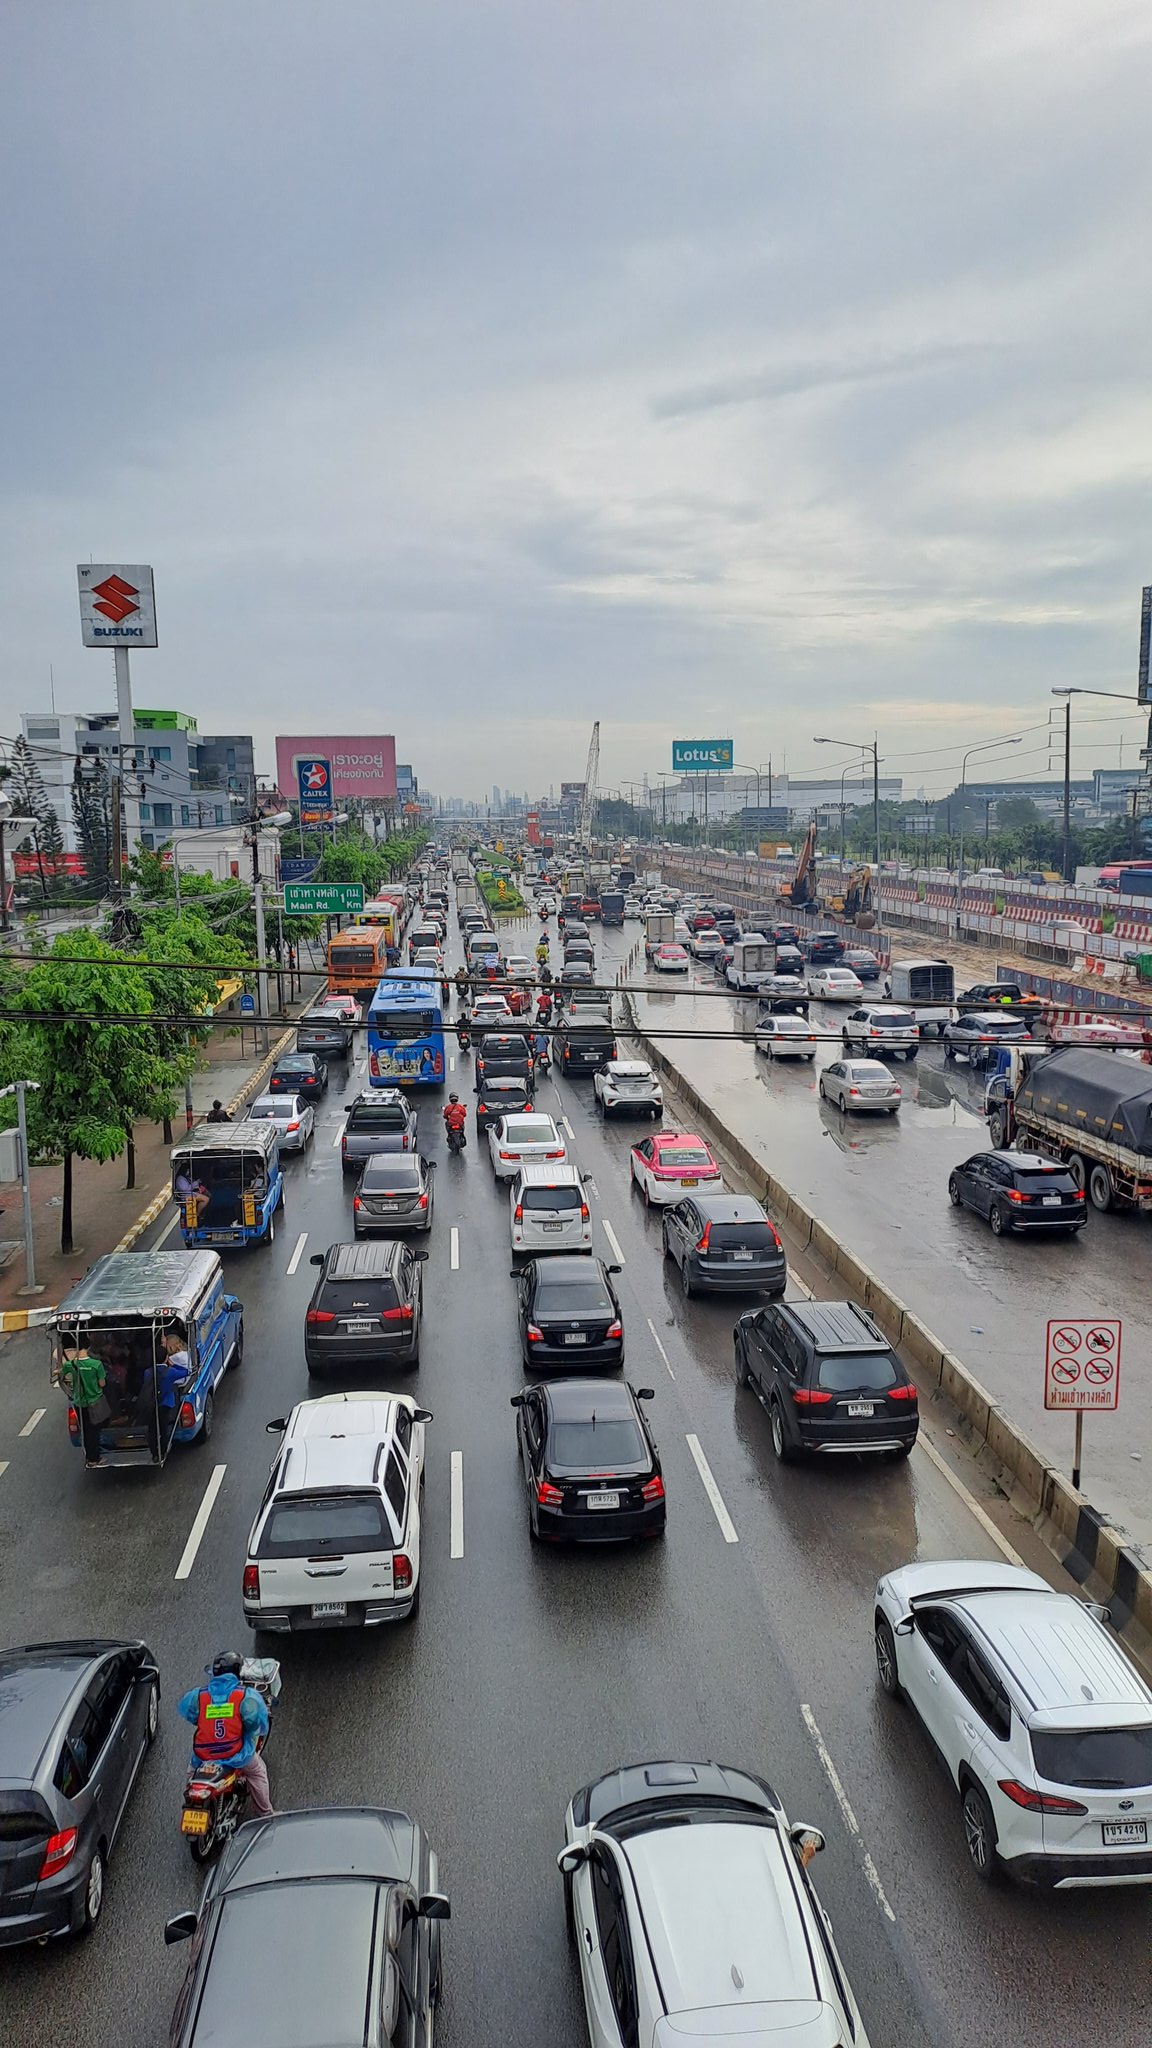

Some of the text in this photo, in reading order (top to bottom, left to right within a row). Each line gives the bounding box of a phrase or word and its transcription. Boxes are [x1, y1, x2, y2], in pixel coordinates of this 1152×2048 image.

[93, 627, 143, 637] SUZUKI
[332, 752, 383, 768] เราจะอยู่
[676, 748, 730, 762] Lotus's
[333, 768, 384, 778] เคียงข้างกัน
[290, 886, 361, 903] เข้าทางหลัก 1 กม.
[290, 901, 313, 910] Main
[316, 901, 330, 909] Rd.
[1051, 1387, 1112, 1404] ห้ามเข้าทางหลัก
[329, 1602, 345, 1611] 8502
[215, 1719, 226, 1739] 5
[1124, 1825, 1144, 1834] 4210
